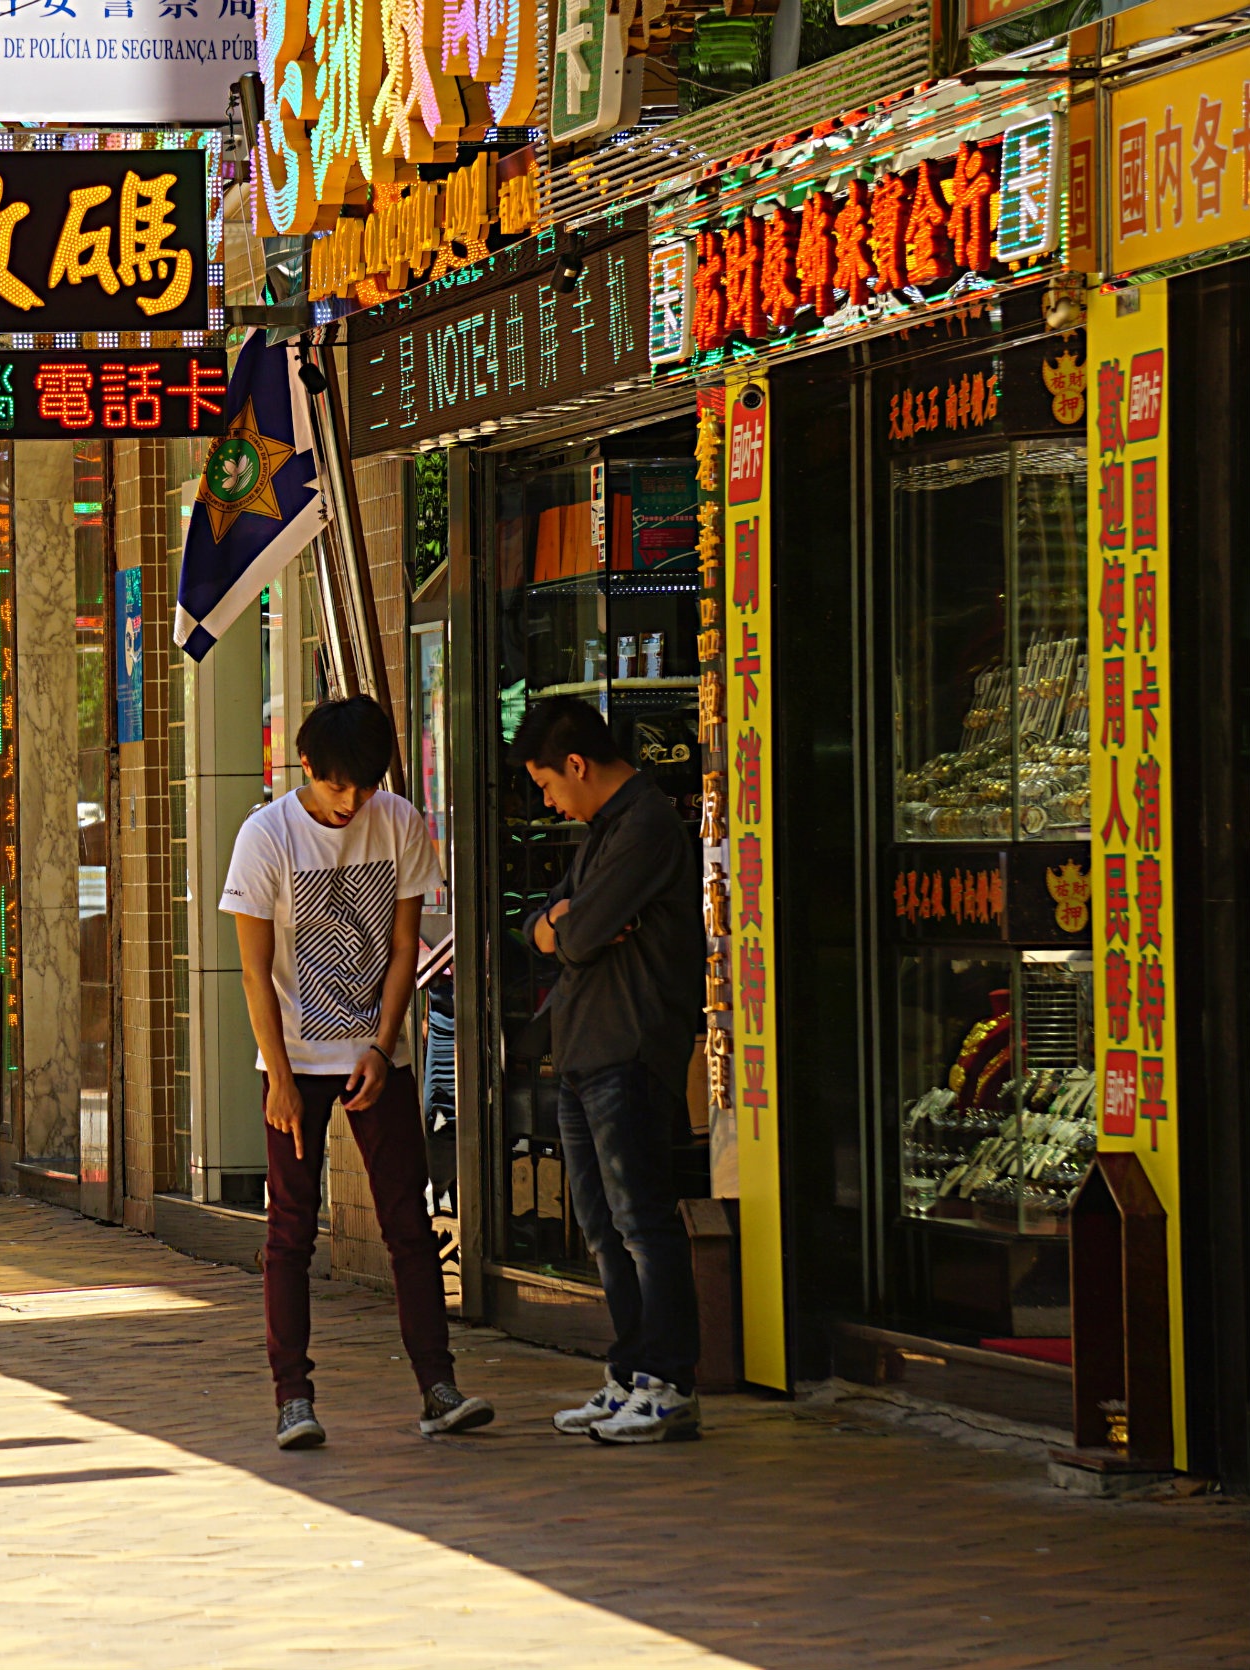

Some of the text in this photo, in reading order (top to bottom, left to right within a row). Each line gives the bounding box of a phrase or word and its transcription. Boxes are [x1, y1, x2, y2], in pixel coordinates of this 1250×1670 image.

[4, 38, 25, 60] DE
[30, 33, 91, 60] POLÍCIA
[96, 38, 118, 60] DE
[121, 38, 218, 65] SEGURANÇA
[34, 359, 227, 431] 電話卡
[1051, 369, 1086, 389] 祐財
[1057, 394, 1080, 420] 押
[1096, 357, 1133, 1045] 歡迎使用人民幣
[732, 514, 769, 1142] 刷卡消費特平
[1060, 902, 1082, 928] 押
